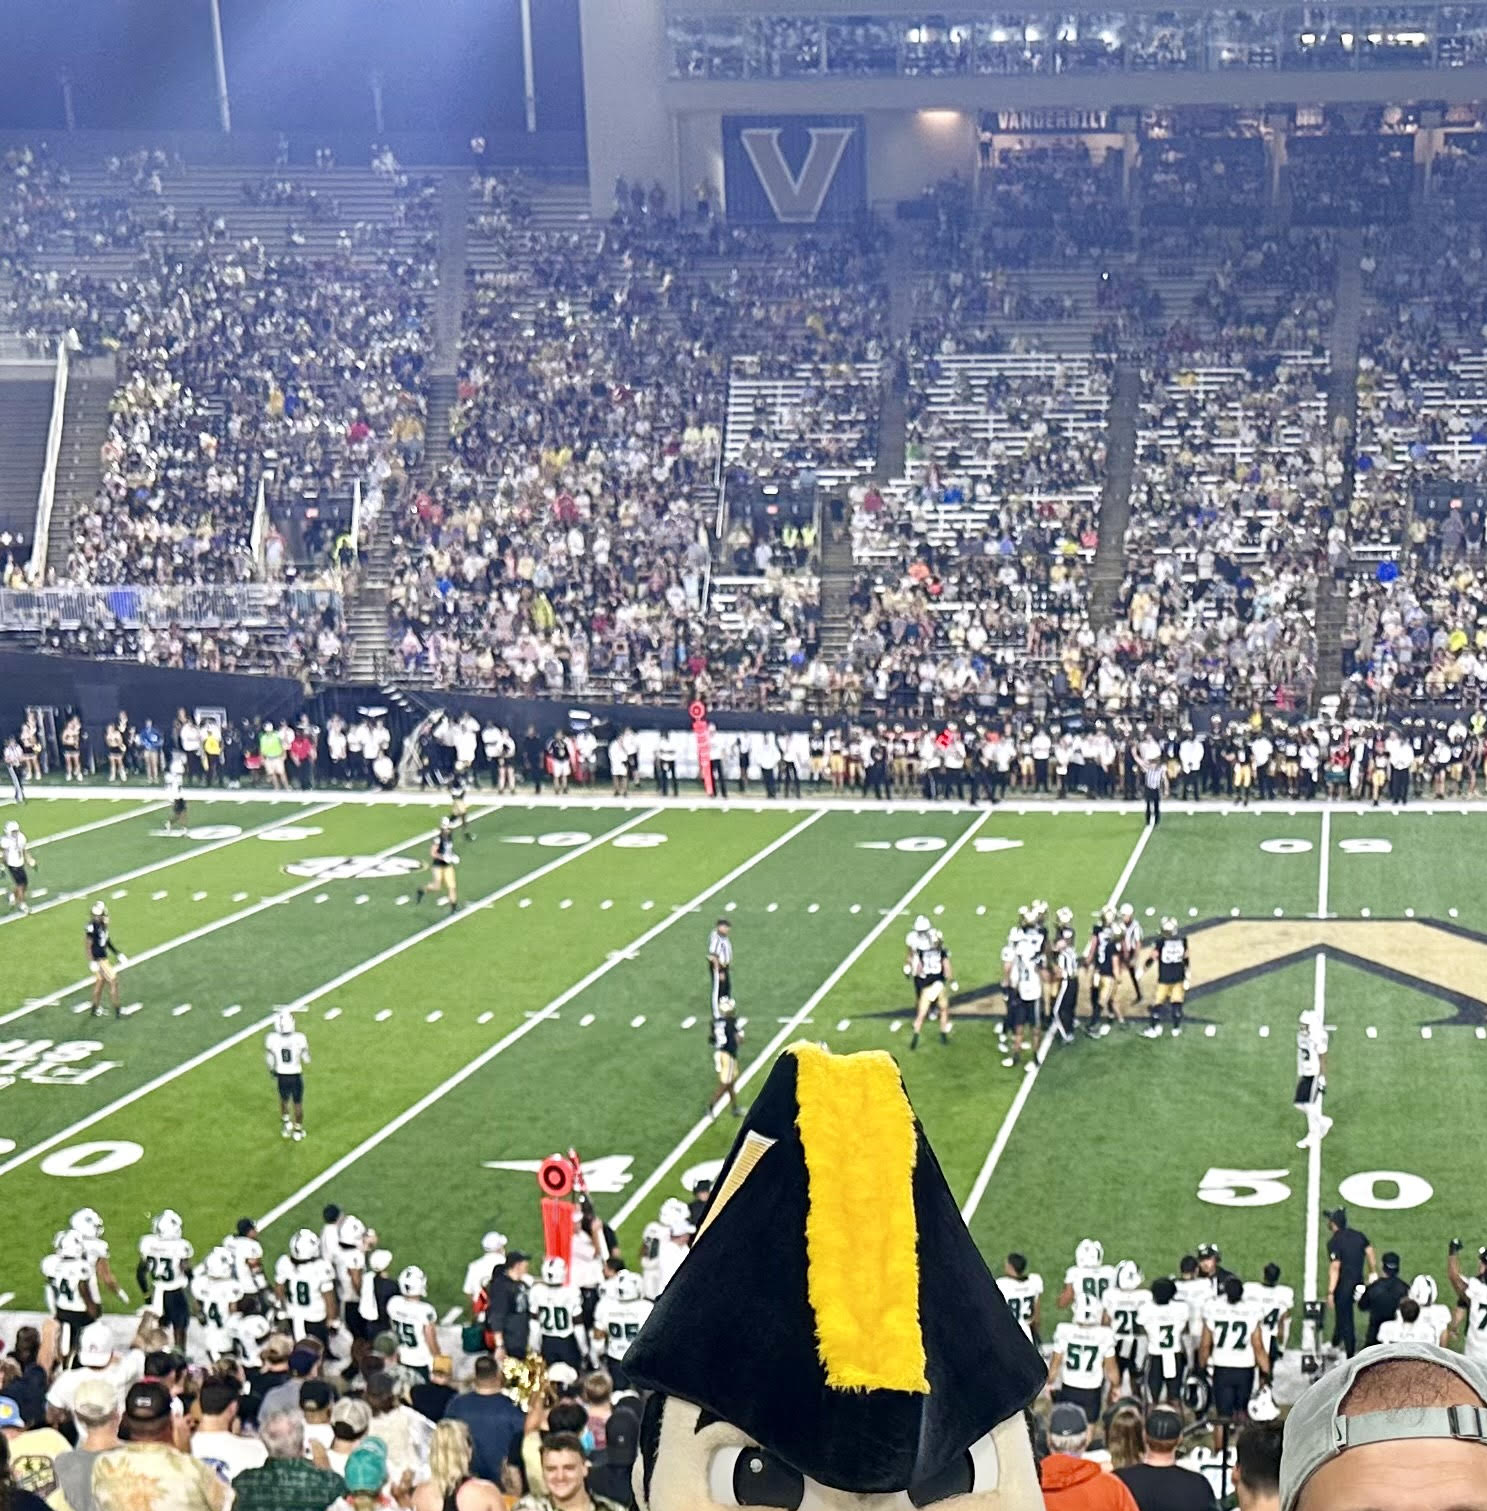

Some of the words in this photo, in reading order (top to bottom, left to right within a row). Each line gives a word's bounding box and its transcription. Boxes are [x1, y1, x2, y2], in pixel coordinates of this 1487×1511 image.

[998, 110, 1107, 129] VANDERBILT
[740, 128, 853, 223] V
[1197, 1167, 1433, 1209] 50
[539, 1306, 568, 1331] 20
[1159, 1325, 1174, 1348] 3
[1214, 1320, 1249, 1350] 72
[1066, 1342, 1099, 1372] 57
